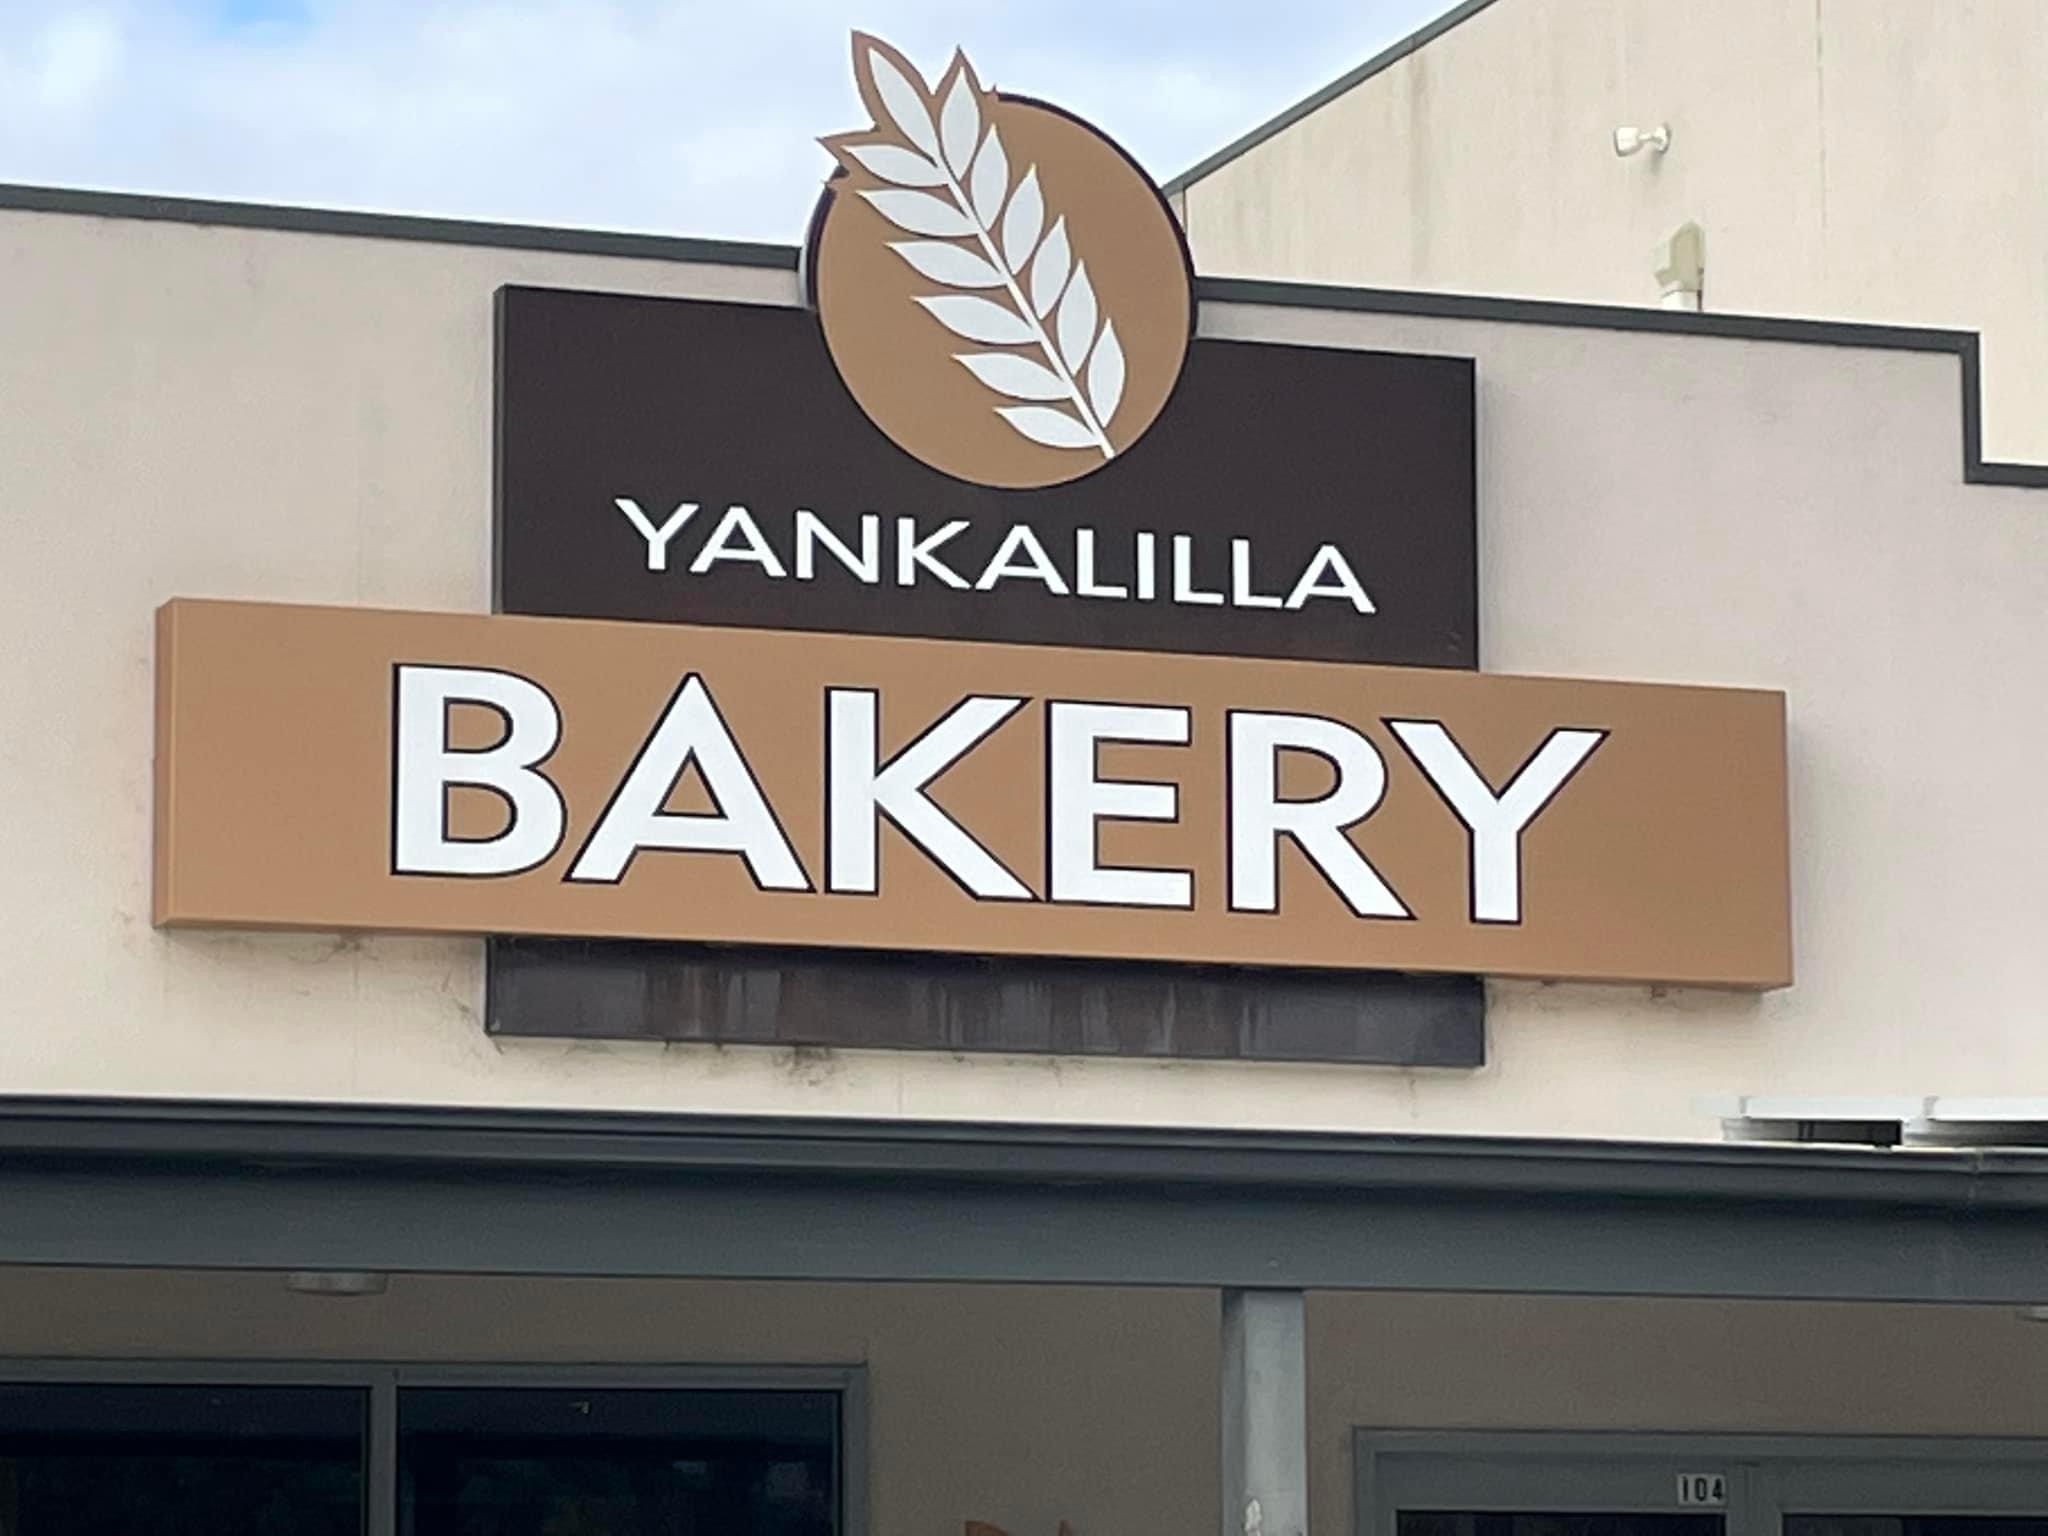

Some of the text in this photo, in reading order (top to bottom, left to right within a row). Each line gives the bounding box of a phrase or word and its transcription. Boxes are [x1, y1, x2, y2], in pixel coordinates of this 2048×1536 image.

[614, 497, 1377, 615] YANKALILLA
[391, 662, 1609, 925] BAKERY
[1682, 1476, 1723, 1502] 104
